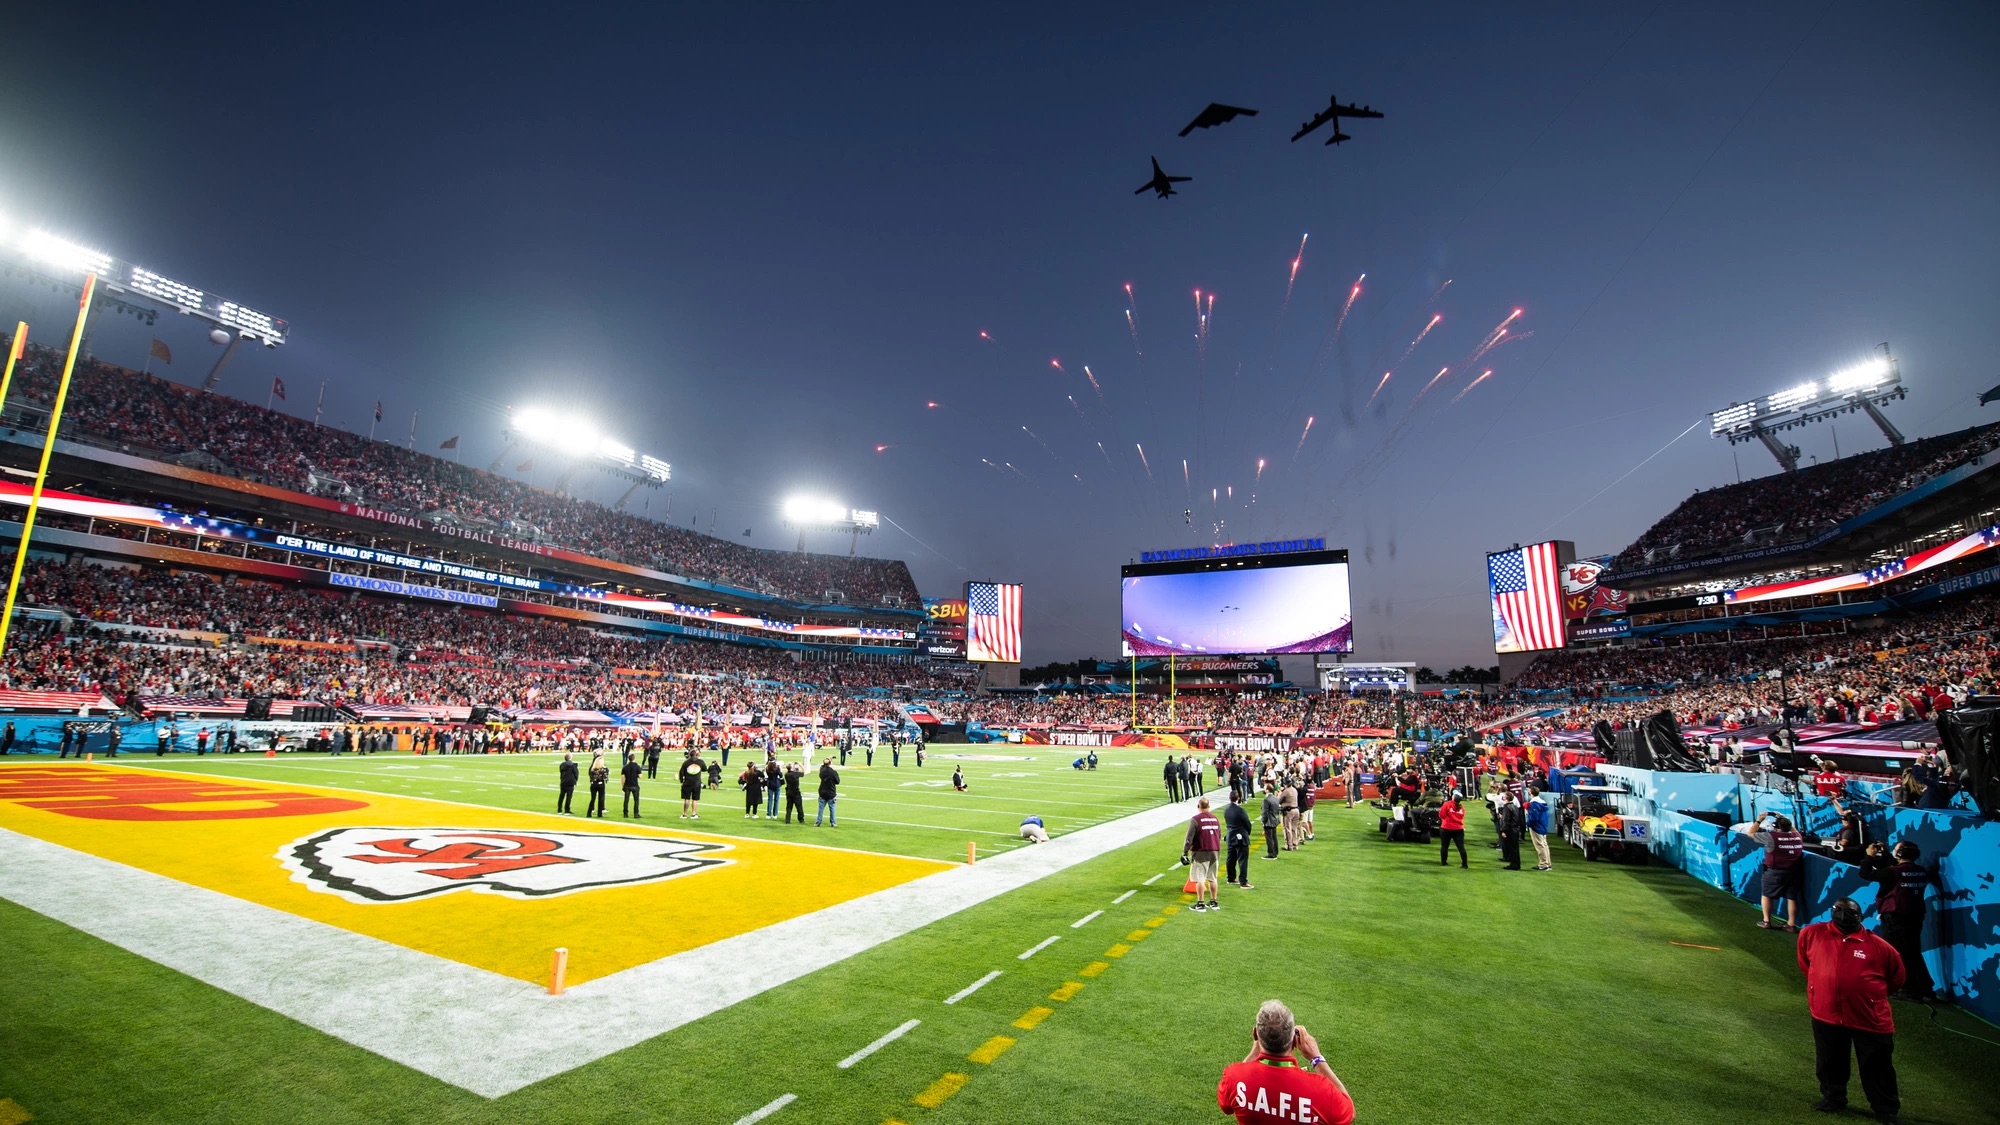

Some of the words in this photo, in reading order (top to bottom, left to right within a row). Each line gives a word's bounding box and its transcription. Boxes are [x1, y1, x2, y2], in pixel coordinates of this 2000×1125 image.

[356, 507, 423, 529] NATIONAL
[431, 521, 494, 544] FOOTBALL
[501, 539, 542, 554] LEAGUE
[1141, 547, 1209, 563] RAYMOND
[1210, 543, 1257, 558] JAMES
[1259, 537, 1324, 554] STADIUM
[276, 535, 303, 548] O'ER
[305, 540, 327, 552] THE
[328, 545, 358, 558] LAND
[360, 550, 374, 560] OF
[376, 553, 396, 564] THE
[396, 556, 421, 568] FREE
[422, 559, 442, 572] AND
[443, 564, 460, 575] THE
[461, 568, 485, 580] HOME
[486, 573, 498, 581] OF
[499, 575, 514, 585] THE
[515, 577, 540, 589] BRAVE
[1616, 568, 1655, 580] ASSISTANCE?
[1656, 566, 1672, 574] TEXT
[1673, 563, 1689, 571] SBLV
[1690, 560, 1699, 568] TO
[1724, 554, 1743, 562] WITH
[1743, 550, 1764, 559] YOUR
[1766, 544, 1803, 556] LOCATION
[332, 573, 403, 593] RAYMOND
[404, 584, 446, 600] JAMES
[448, 591, 497, 607] STADIUM
[1939, 576, 1972, 594] SUPER
[1696, 595, 1718, 606] 7:30
[930, 604, 967, 619] SBLV
[683, 627, 707, 637] SUPER
[710, 631, 729, 640] BOWL
[928, 646, 957, 654] verizon
[1163, 663, 1192, 671] CHIEFS
[1201, 662, 1259, 671] BUCCANEERS
[1077, 733, 1101, 746] BOWL
[1102, 735, 1112, 747] LV
[1247, 738, 1276, 751] BOWL
[1277, 739, 1290, 752] LV
[1235, 1081, 1319, 1123] S.A.F.E.
